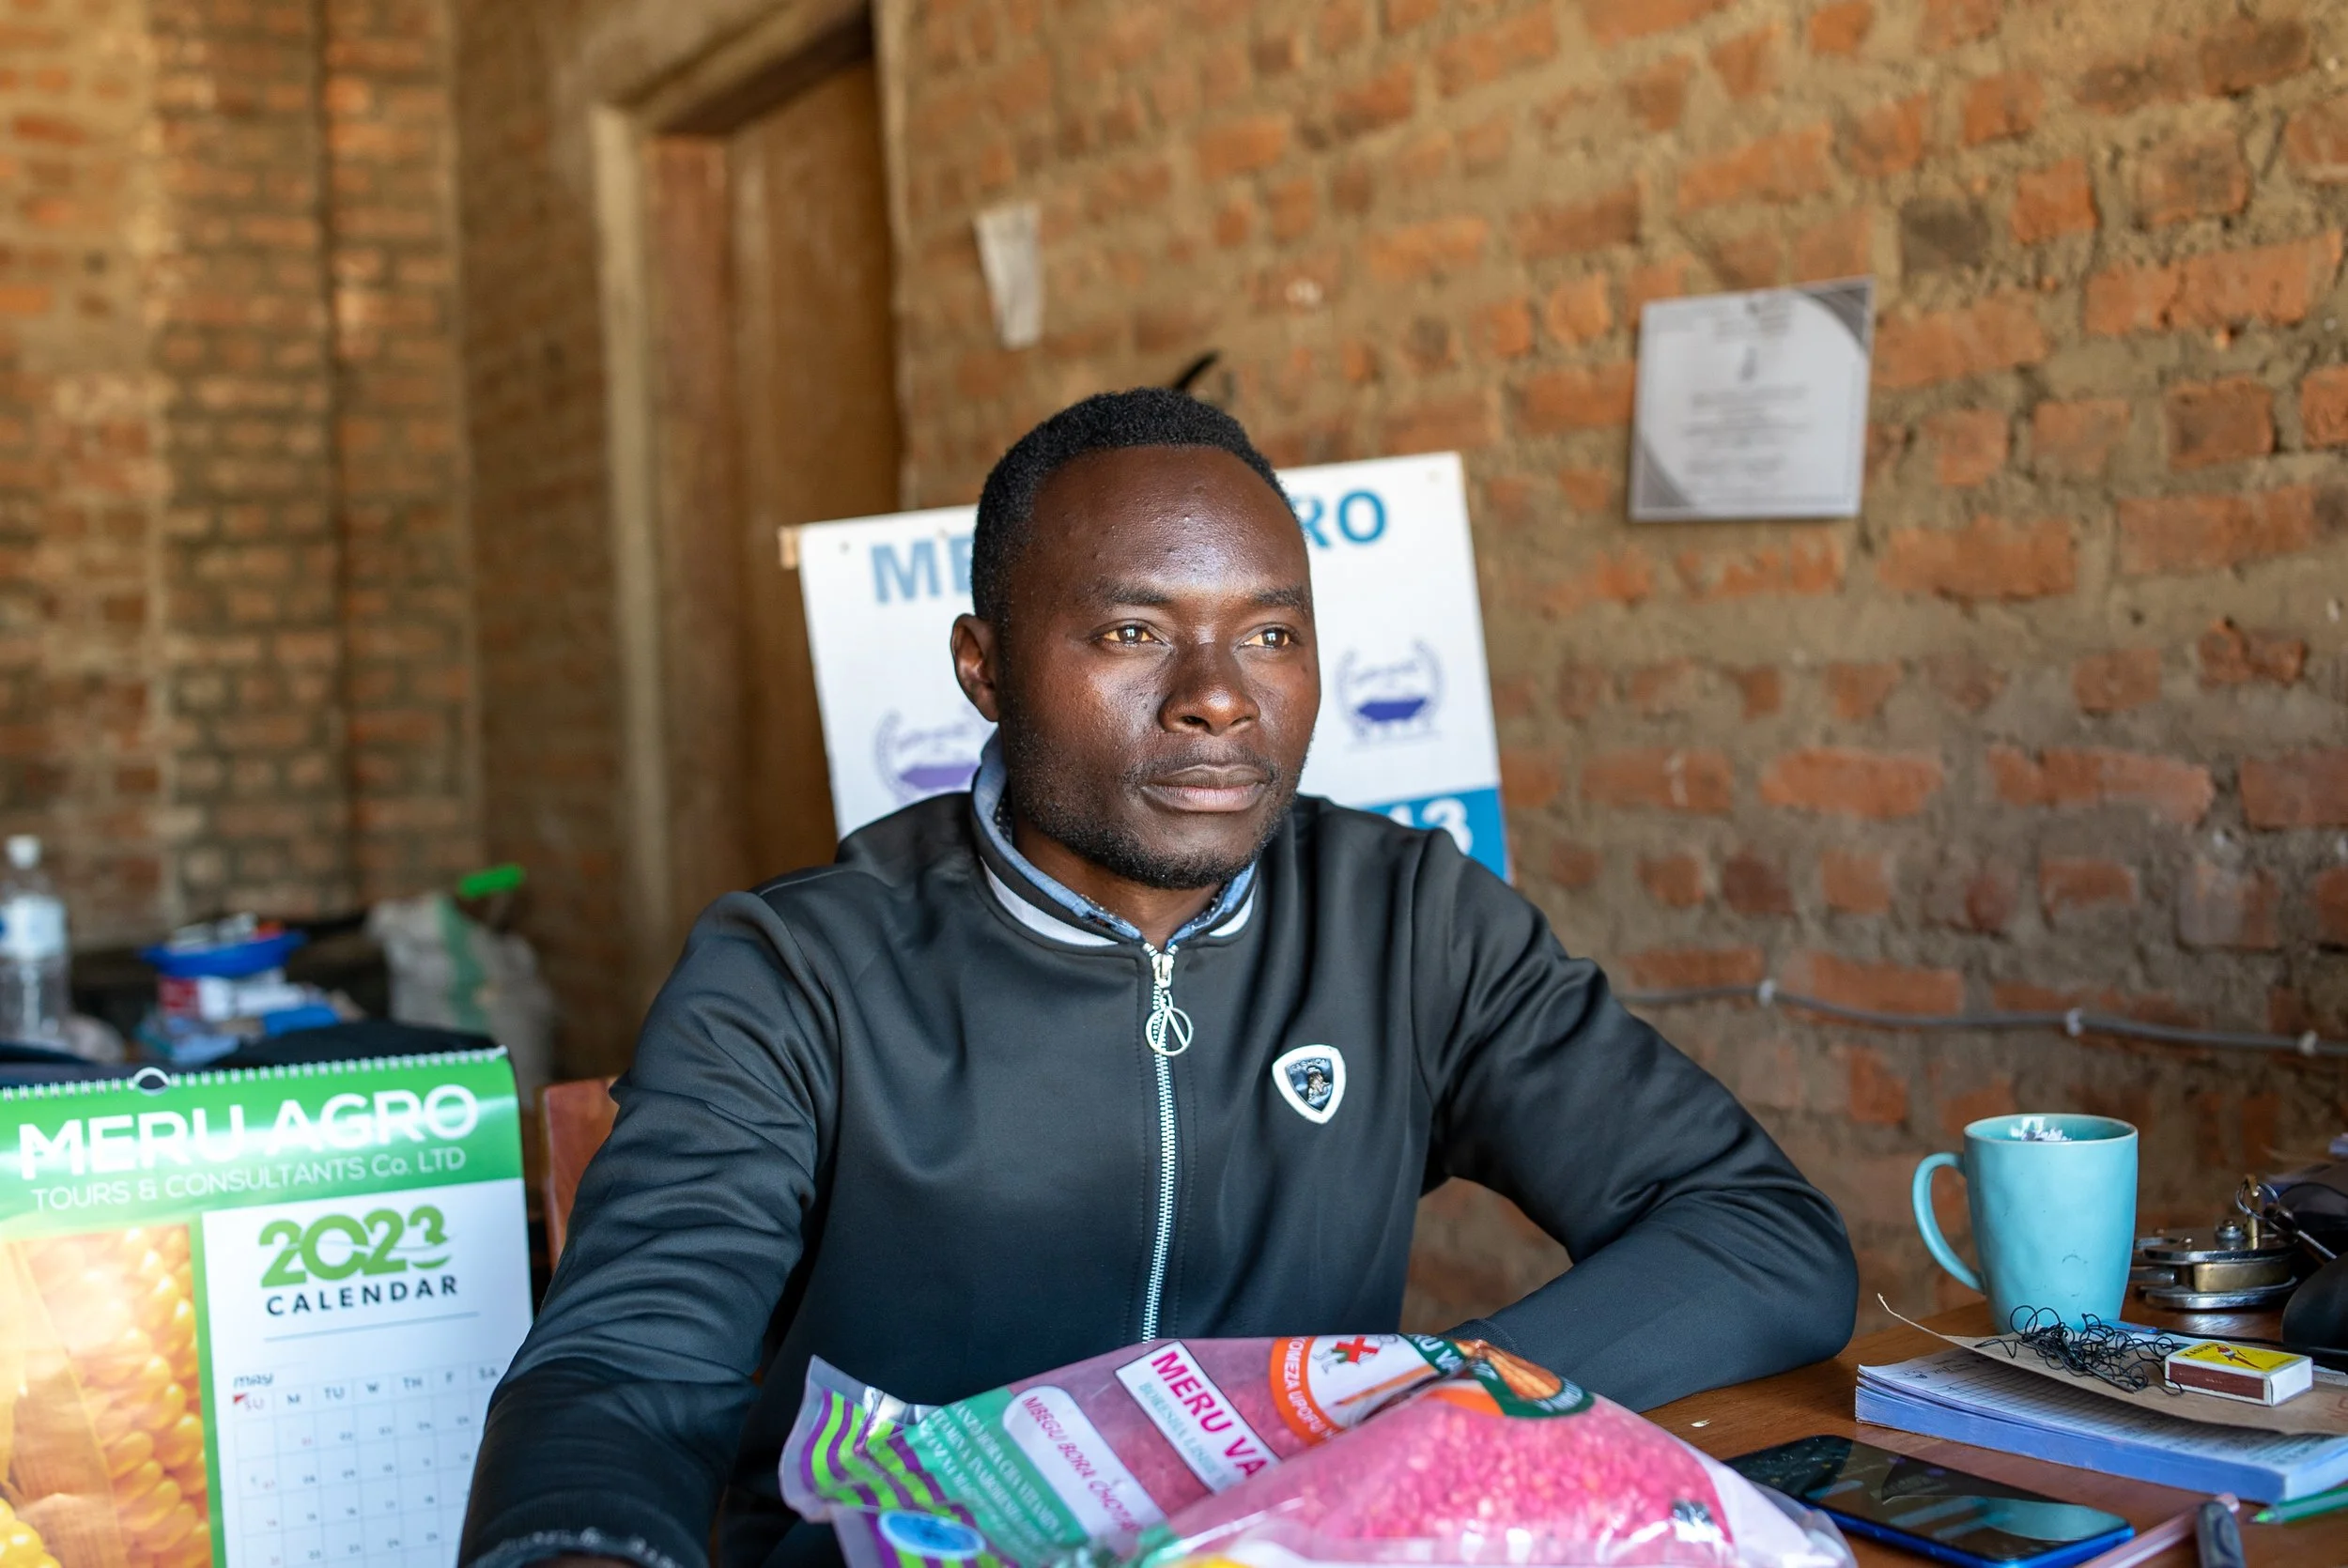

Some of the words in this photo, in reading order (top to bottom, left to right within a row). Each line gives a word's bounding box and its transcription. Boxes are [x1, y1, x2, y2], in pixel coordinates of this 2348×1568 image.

[871, 536, 973, 603] ME
[1304, 489, 1385, 547] RO
[19, 1104, 246, 1181] MERU
[265, 1084, 479, 1157] AGRO
[31, 1180, 131, 1211] TOURS
[138, 1178, 159, 1202] &
[165, 1156, 365, 1198] CONSULTANTS
[418, 1146, 467, 1174] LTD
[258, 1205, 451, 1289] 2023
[267, 1275, 458, 1316] CALENDAR
[324, 1386, 345, 1401] TU
[1151, 1351, 1234, 1433] MERU
[1284, 1337, 1305, 1391] OMEZA
[1022, 1396, 1068, 1441] MBEGU
[1058, 1442, 1097, 1479] BORA
